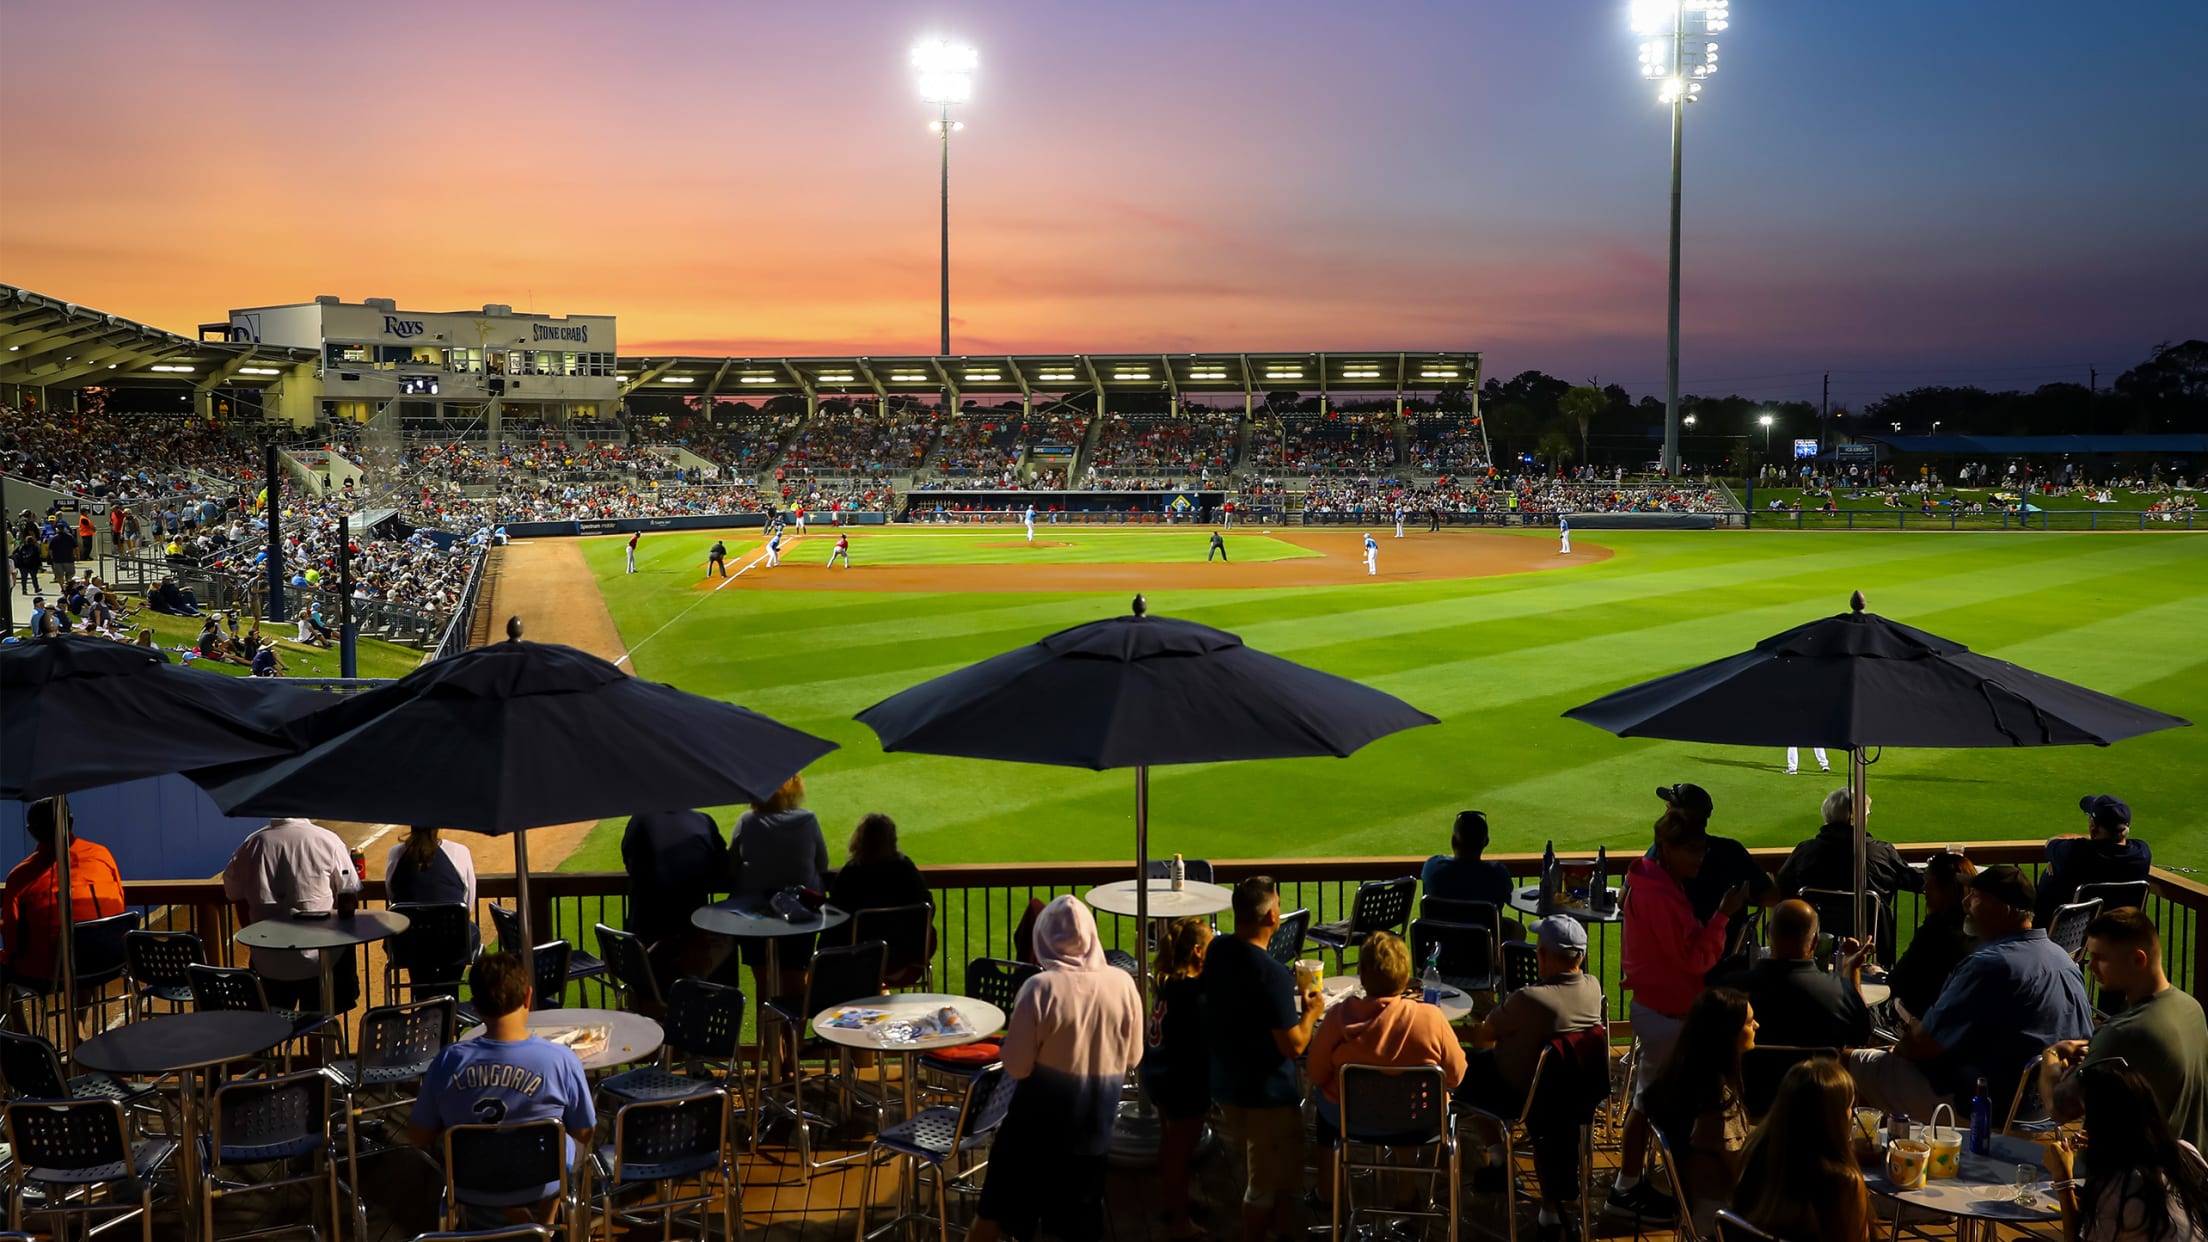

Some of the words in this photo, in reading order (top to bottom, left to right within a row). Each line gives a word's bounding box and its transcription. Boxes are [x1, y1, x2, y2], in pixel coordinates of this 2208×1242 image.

[533, 323, 560, 342] STONE
[560, 324, 588, 343] CRABS
[452, 1063, 543, 1097] LONGORIA
